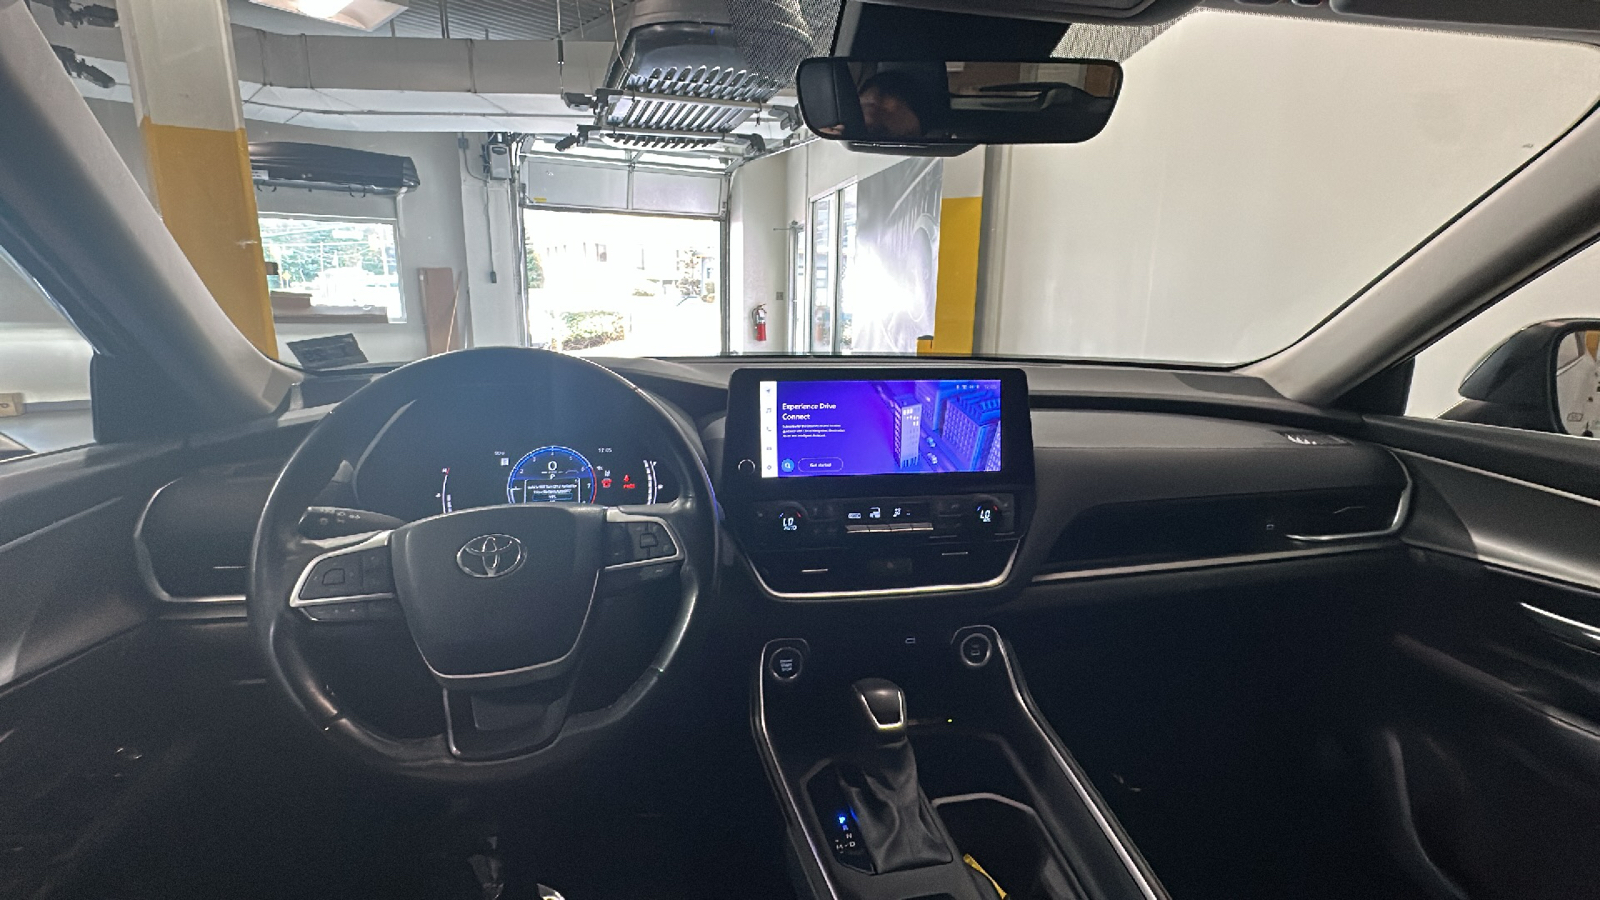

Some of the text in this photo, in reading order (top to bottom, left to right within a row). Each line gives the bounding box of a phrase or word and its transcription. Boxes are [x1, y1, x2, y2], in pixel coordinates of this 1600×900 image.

[782, 402, 837, 411] Experience Drive
[547, 460, 558, 471] 0
